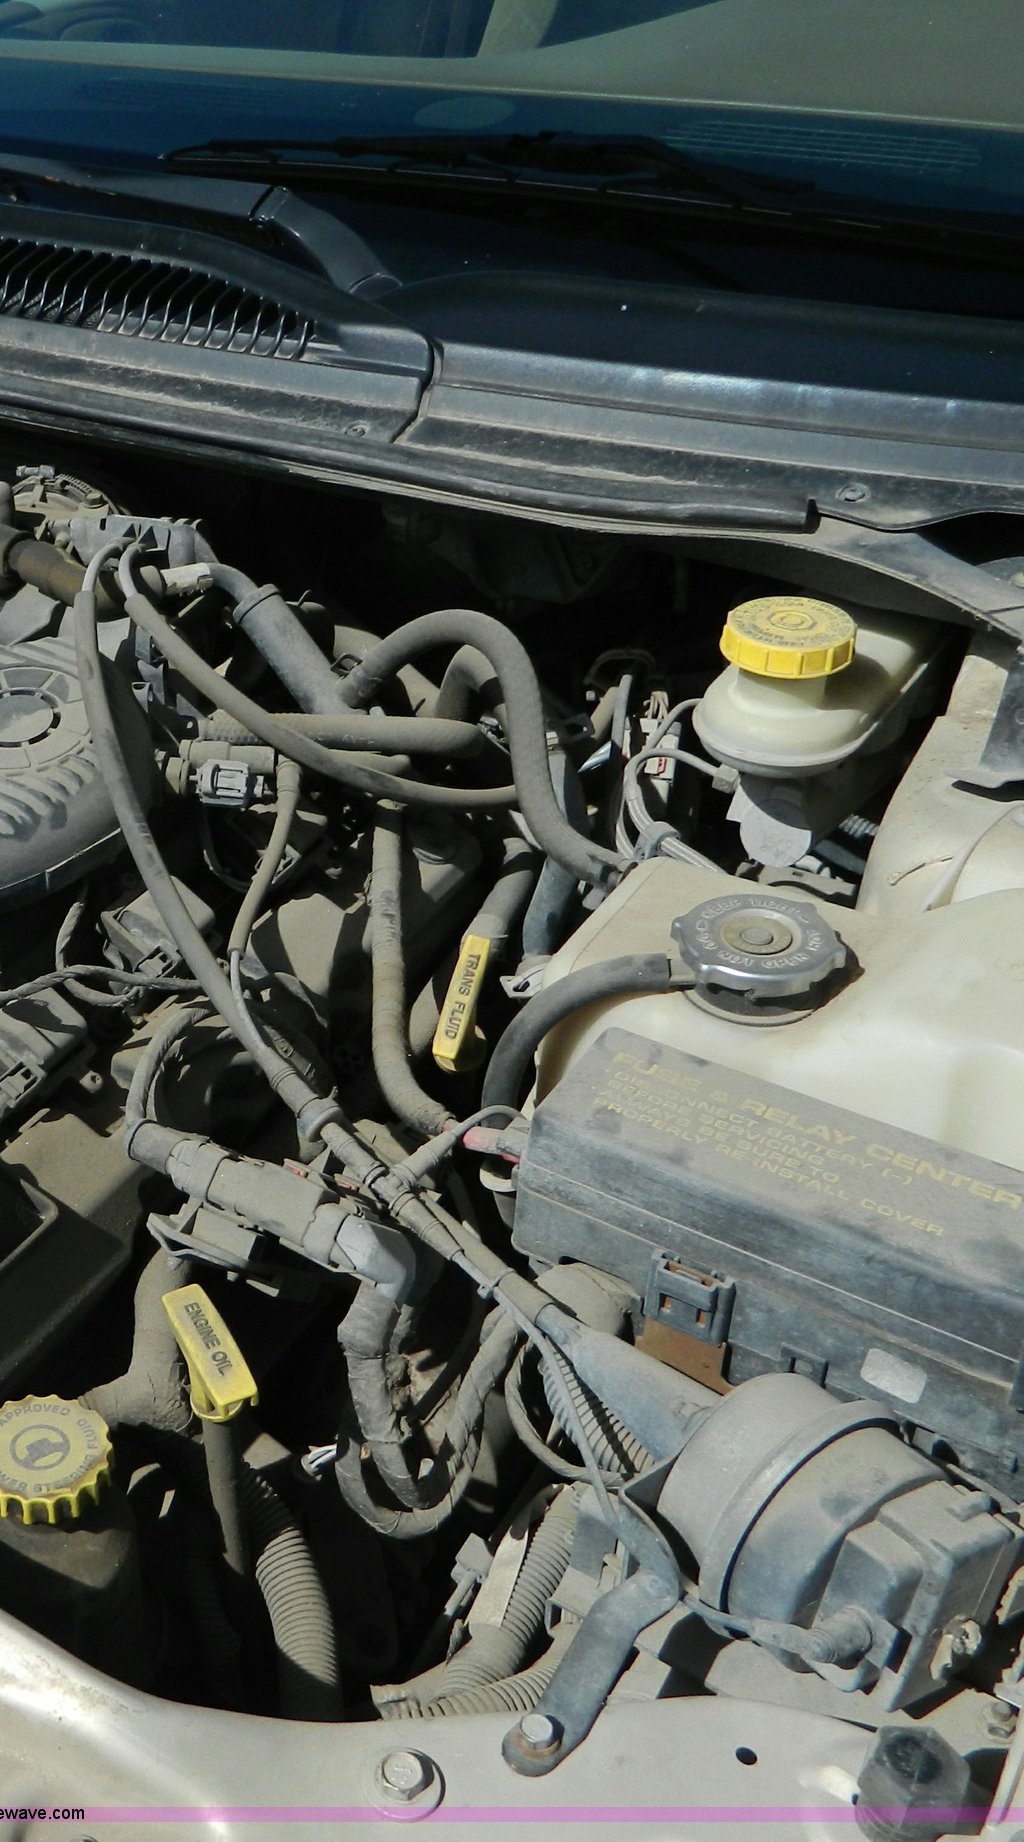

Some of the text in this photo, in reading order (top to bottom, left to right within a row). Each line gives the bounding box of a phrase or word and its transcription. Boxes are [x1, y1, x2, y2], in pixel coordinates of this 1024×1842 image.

[717, 951, 753, 966] NOT
[761, 952, 809, 969] OPEN
[444, 953, 481, 1040] TRANS FLUID
[613, 1051, 703, 1093] FUSE
[740, 1097, 858, 1145] RELAY
[866, 1143, 1023, 1210] CENTER
[698, 1113, 826, 1167] SERVICING
[766, 1126, 873, 1169] BATTERY
[592, 1097, 709, 1145] PROPERLY
[860, 1198, 945, 1237] COVER
[737, 1138, 802, 1170] SURE
[809, 1165, 840, 1183] TO
[184, 1302, 233, 1377] ENGINE OIL
[77, 1418, 98, 1449] FLUID
